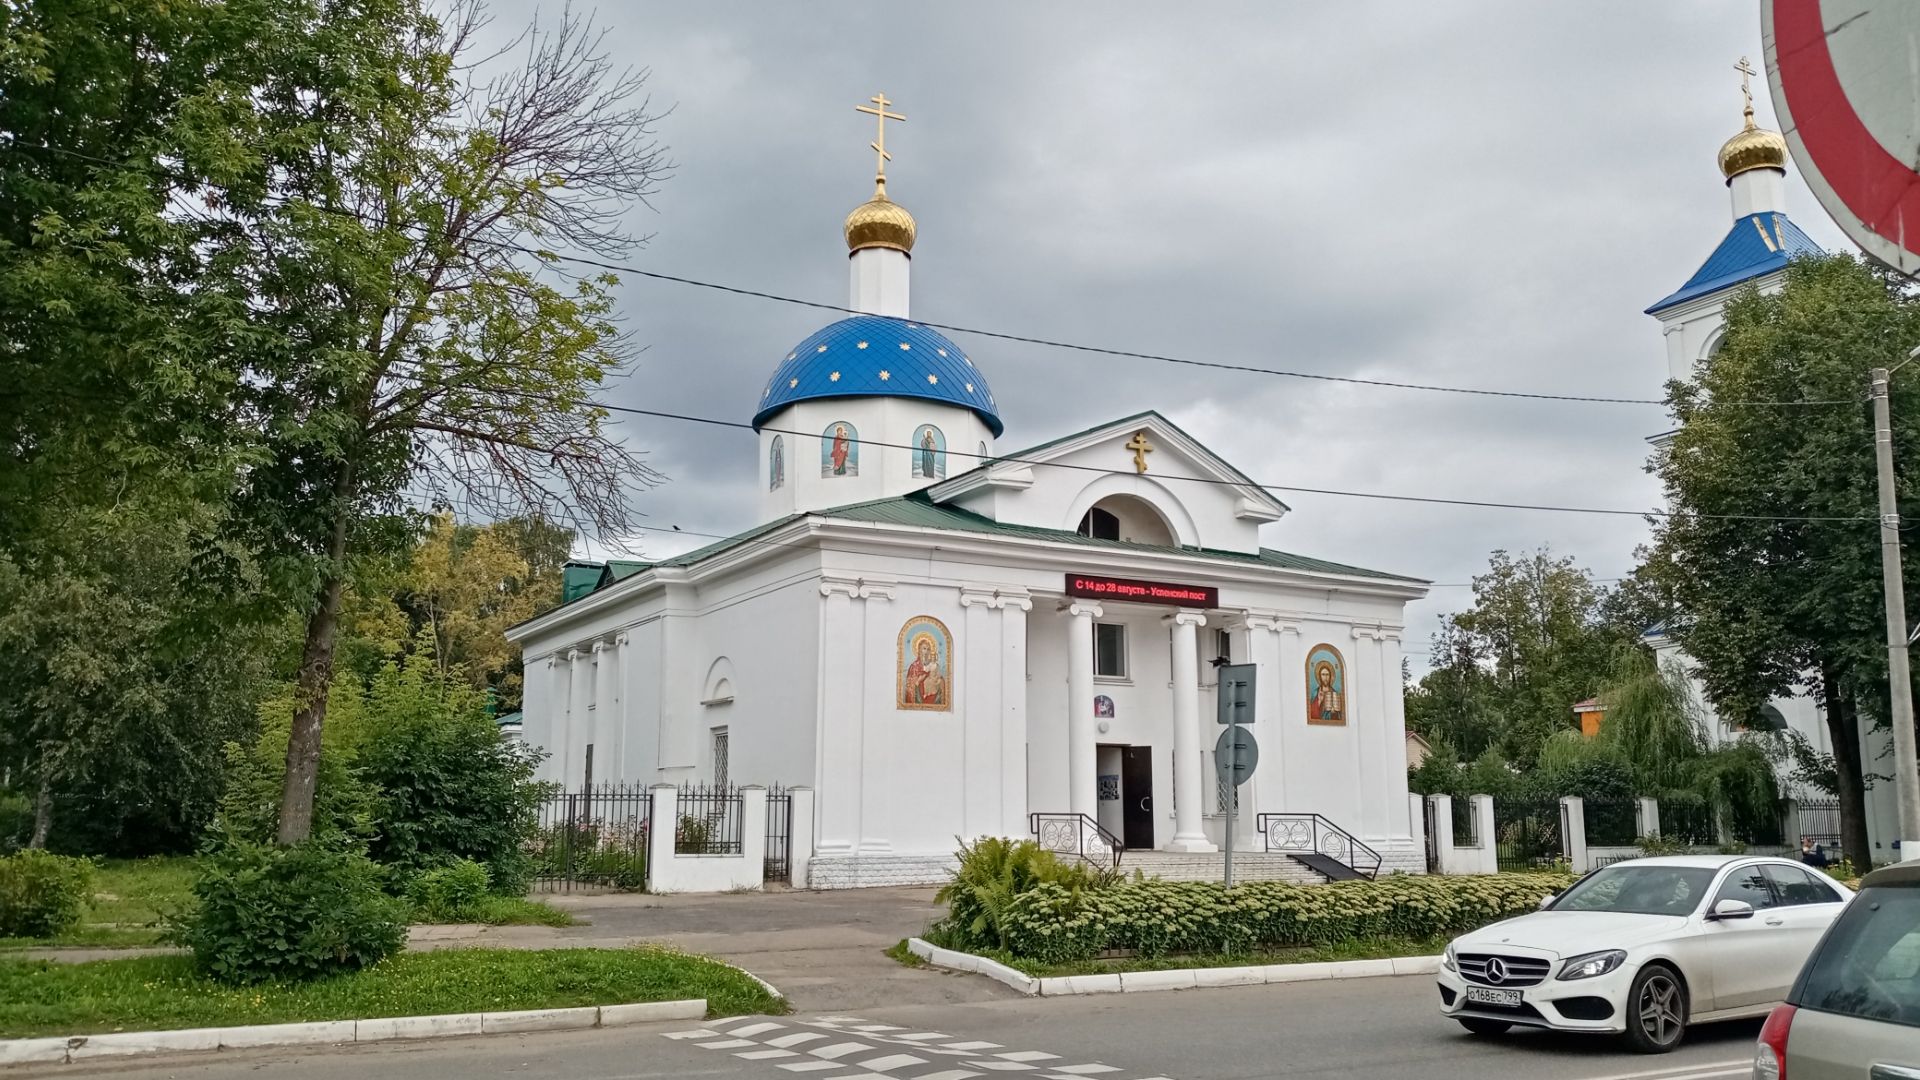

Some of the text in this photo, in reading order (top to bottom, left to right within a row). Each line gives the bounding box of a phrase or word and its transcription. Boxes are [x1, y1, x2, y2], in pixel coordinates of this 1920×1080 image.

[1076, 580, 1084, 589] С
[1085, 581, 1094, 590] 14
[1095, 583, 1106, 592] до
[1106, 583, 1116, 593] 28
[1117, 585, 1145, 596] августа
[1151, 587, 1188, 599] Успенский
[1189, 591, 1206, 601] пост
[1503, 991, 1518, 1001] 799
